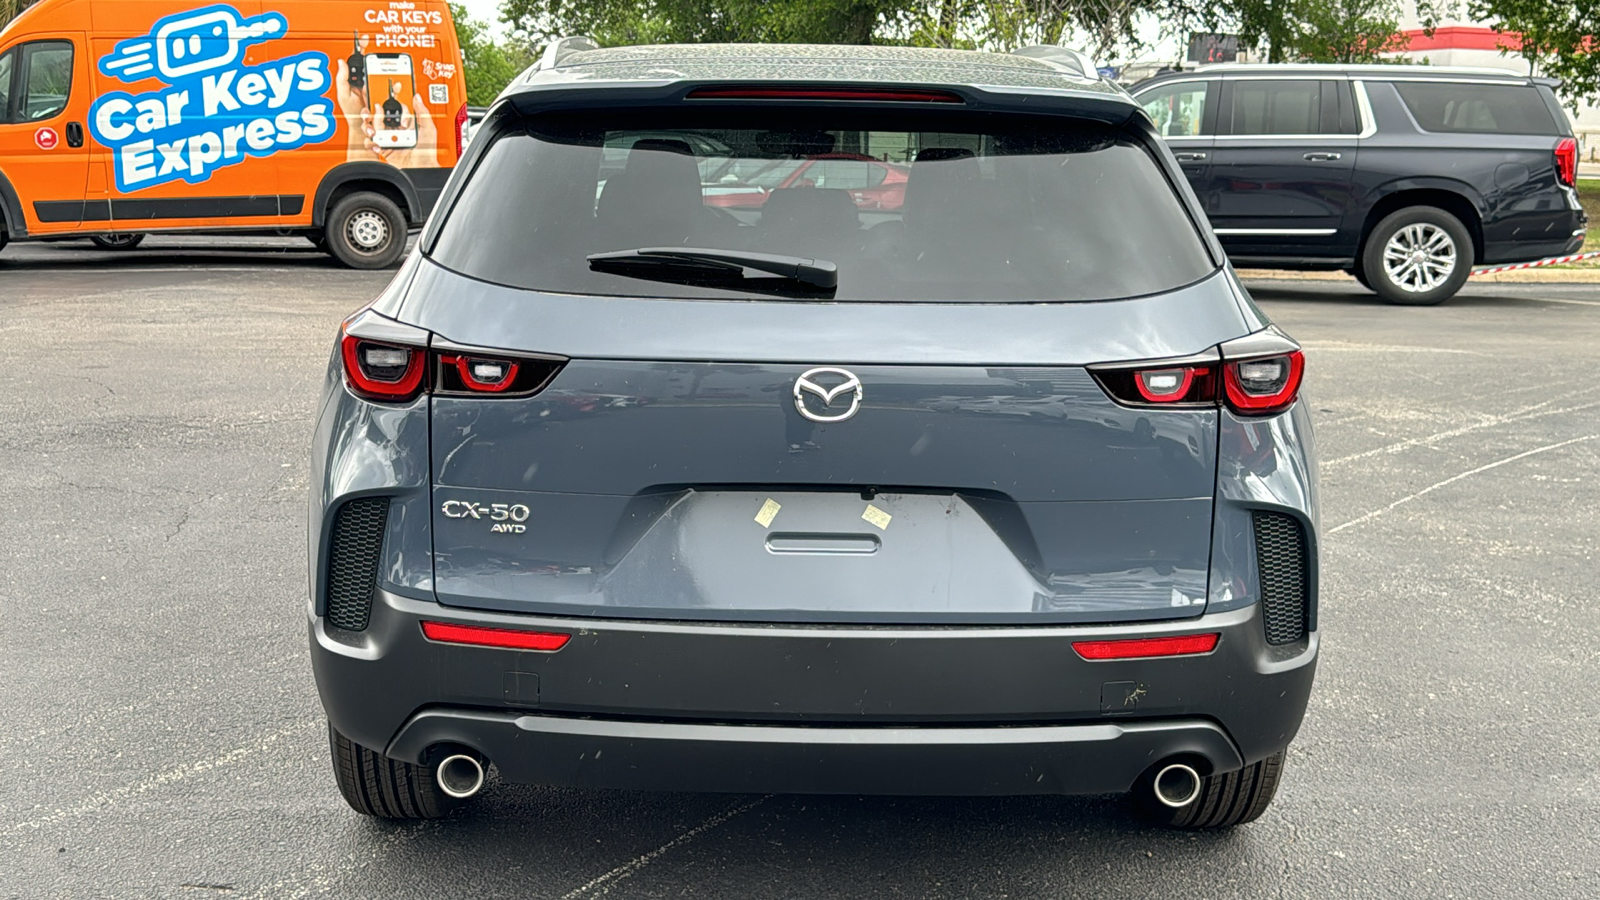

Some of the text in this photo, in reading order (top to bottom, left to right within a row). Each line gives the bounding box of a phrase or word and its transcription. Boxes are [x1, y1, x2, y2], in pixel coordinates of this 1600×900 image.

[389, 1, 415, 10] make
[364, 10, 442, 24] CAR KEYS
[383, 24, 427, 35] with your
[375, 34, 435, 48] PHONE!
[96, 58, 325, 140] Car Keys
[121, 104, 329, 185] Express
[441, 500, 530, 522] CX-50
[490, 523, 527, 534] AWD
